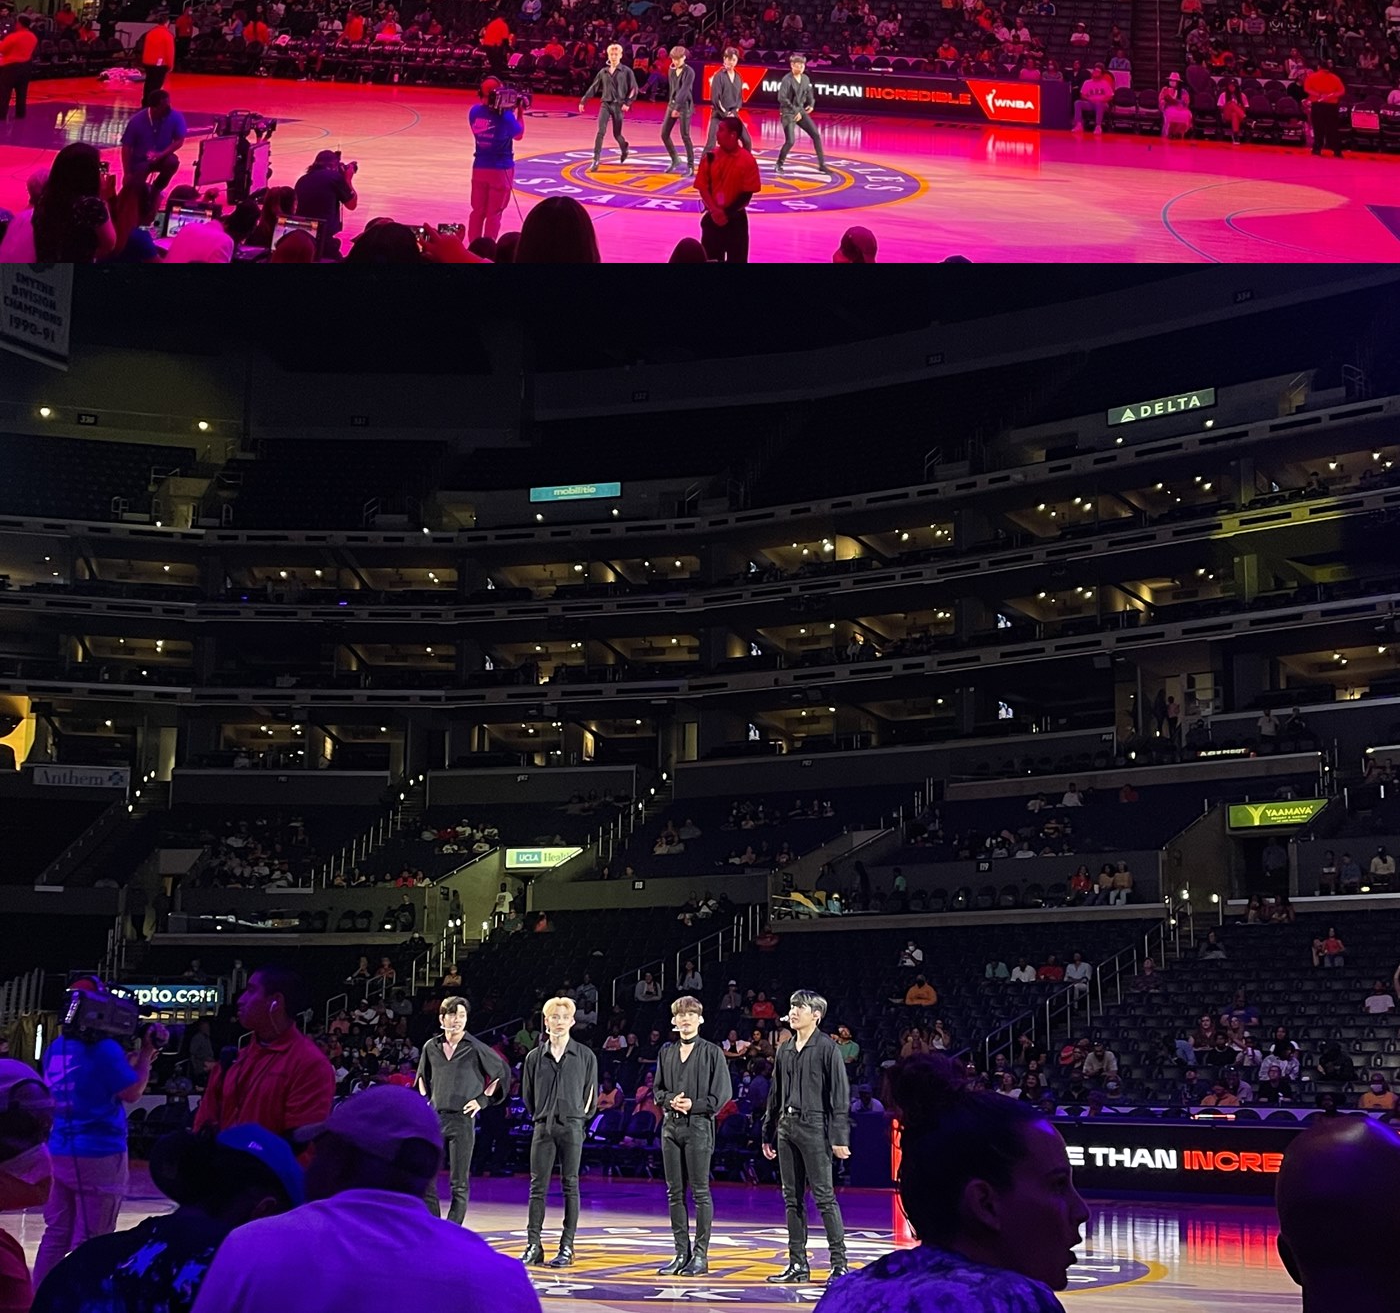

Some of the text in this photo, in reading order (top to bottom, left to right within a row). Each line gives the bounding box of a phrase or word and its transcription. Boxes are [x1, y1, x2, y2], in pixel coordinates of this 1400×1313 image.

[817, 83, 863, 98] THAN
[866, 86, 972, 105] INCREDIBLE
[994, 98, 1035, 110] WNBA
[1140, 395, 1201, 418] DELTA
[43, 770, 104, 786] Anthem
[519, 854, 539, 862] UCLA
[1088, 1147, 1178, 1169] THAN
